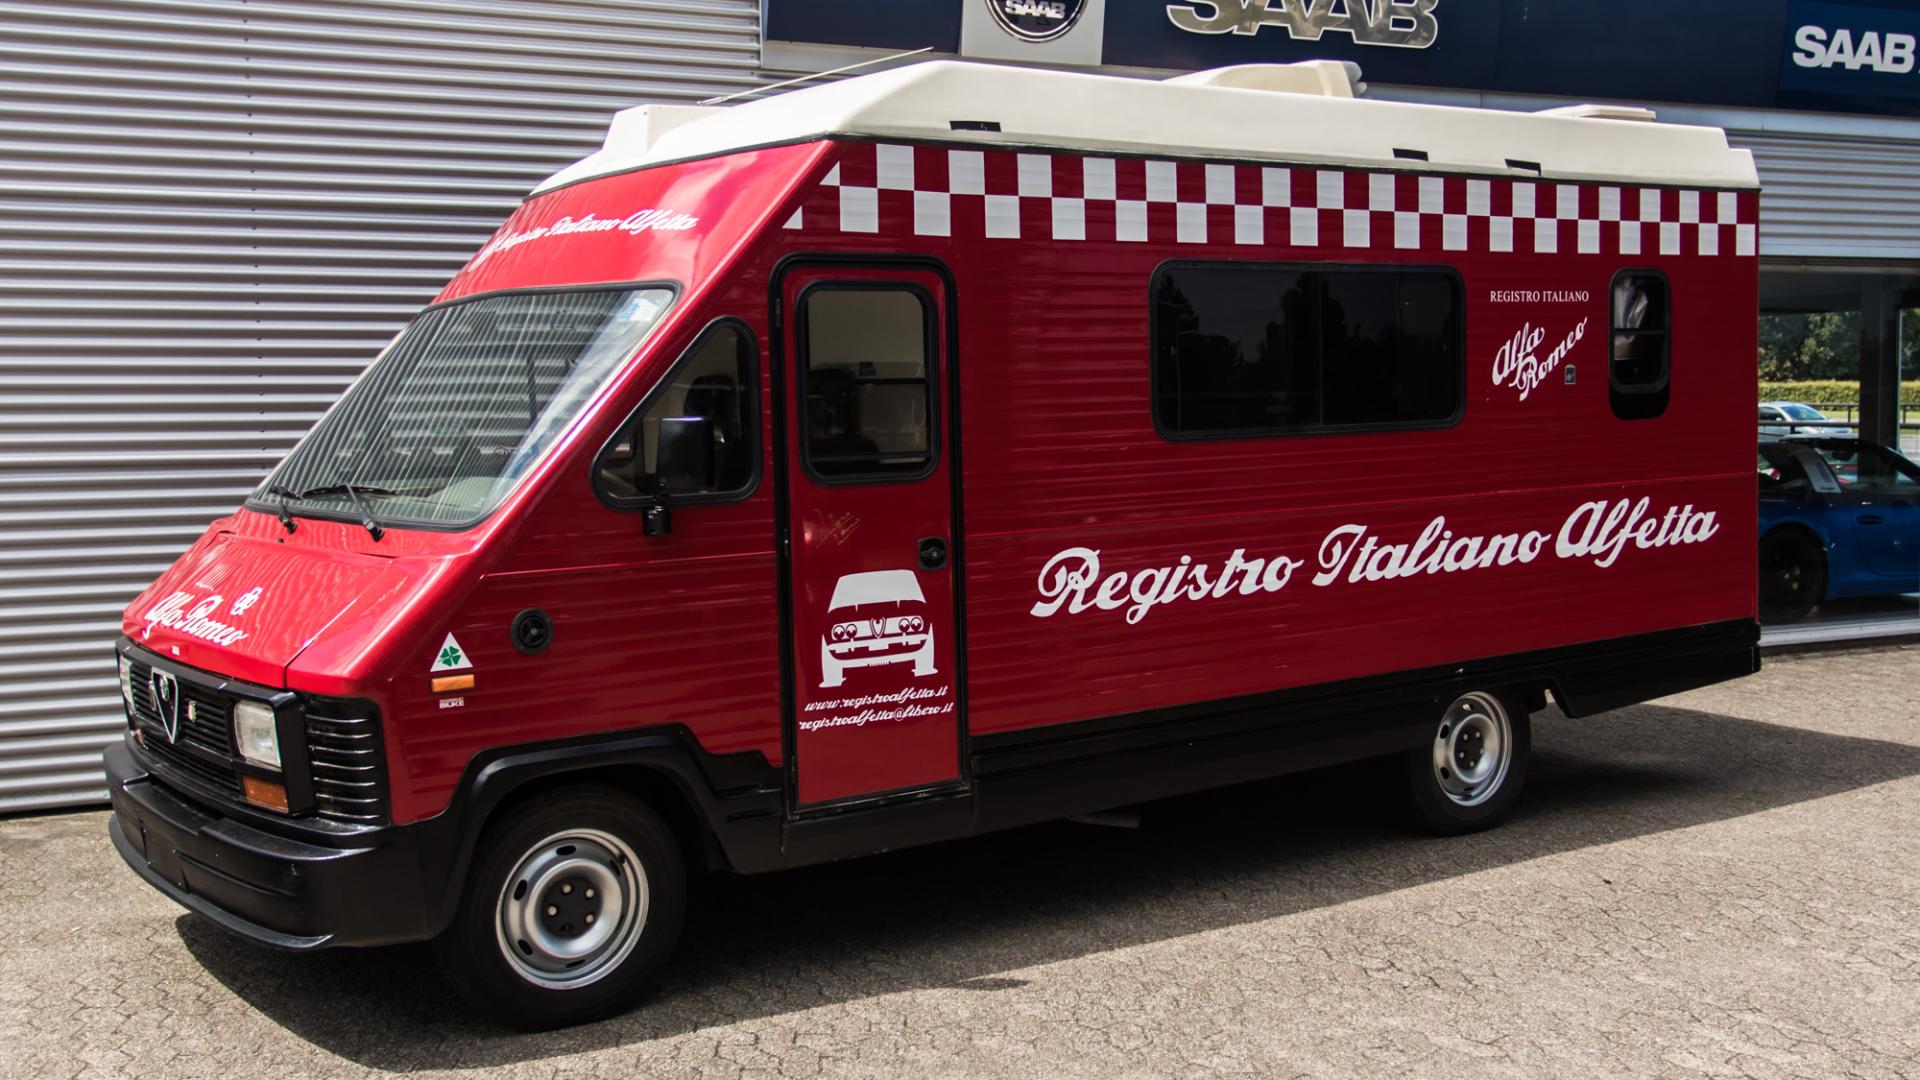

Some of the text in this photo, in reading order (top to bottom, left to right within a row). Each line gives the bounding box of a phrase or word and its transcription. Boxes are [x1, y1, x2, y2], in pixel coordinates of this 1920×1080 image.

[1004, 0, 1066, 19] SAAB
[1792, 25, 1916, 74] SAAB
[618, 209, 699, 235] Alfetta
[1490, 290, 1590, 303] REGISTRO ITALIANO
[1492, 321, 1546, 386] Alfa
[1508, 316, 1588, 402] Romeo
[1030, 496, 1720, 625] Registro Italiano Alfetta
[143, 591, 250, 647] Alfa Romeo
[799, 702, 954, 732] registroalfetta@libero.it
[804, 686, 949, 712] www.registroalfetta.it
